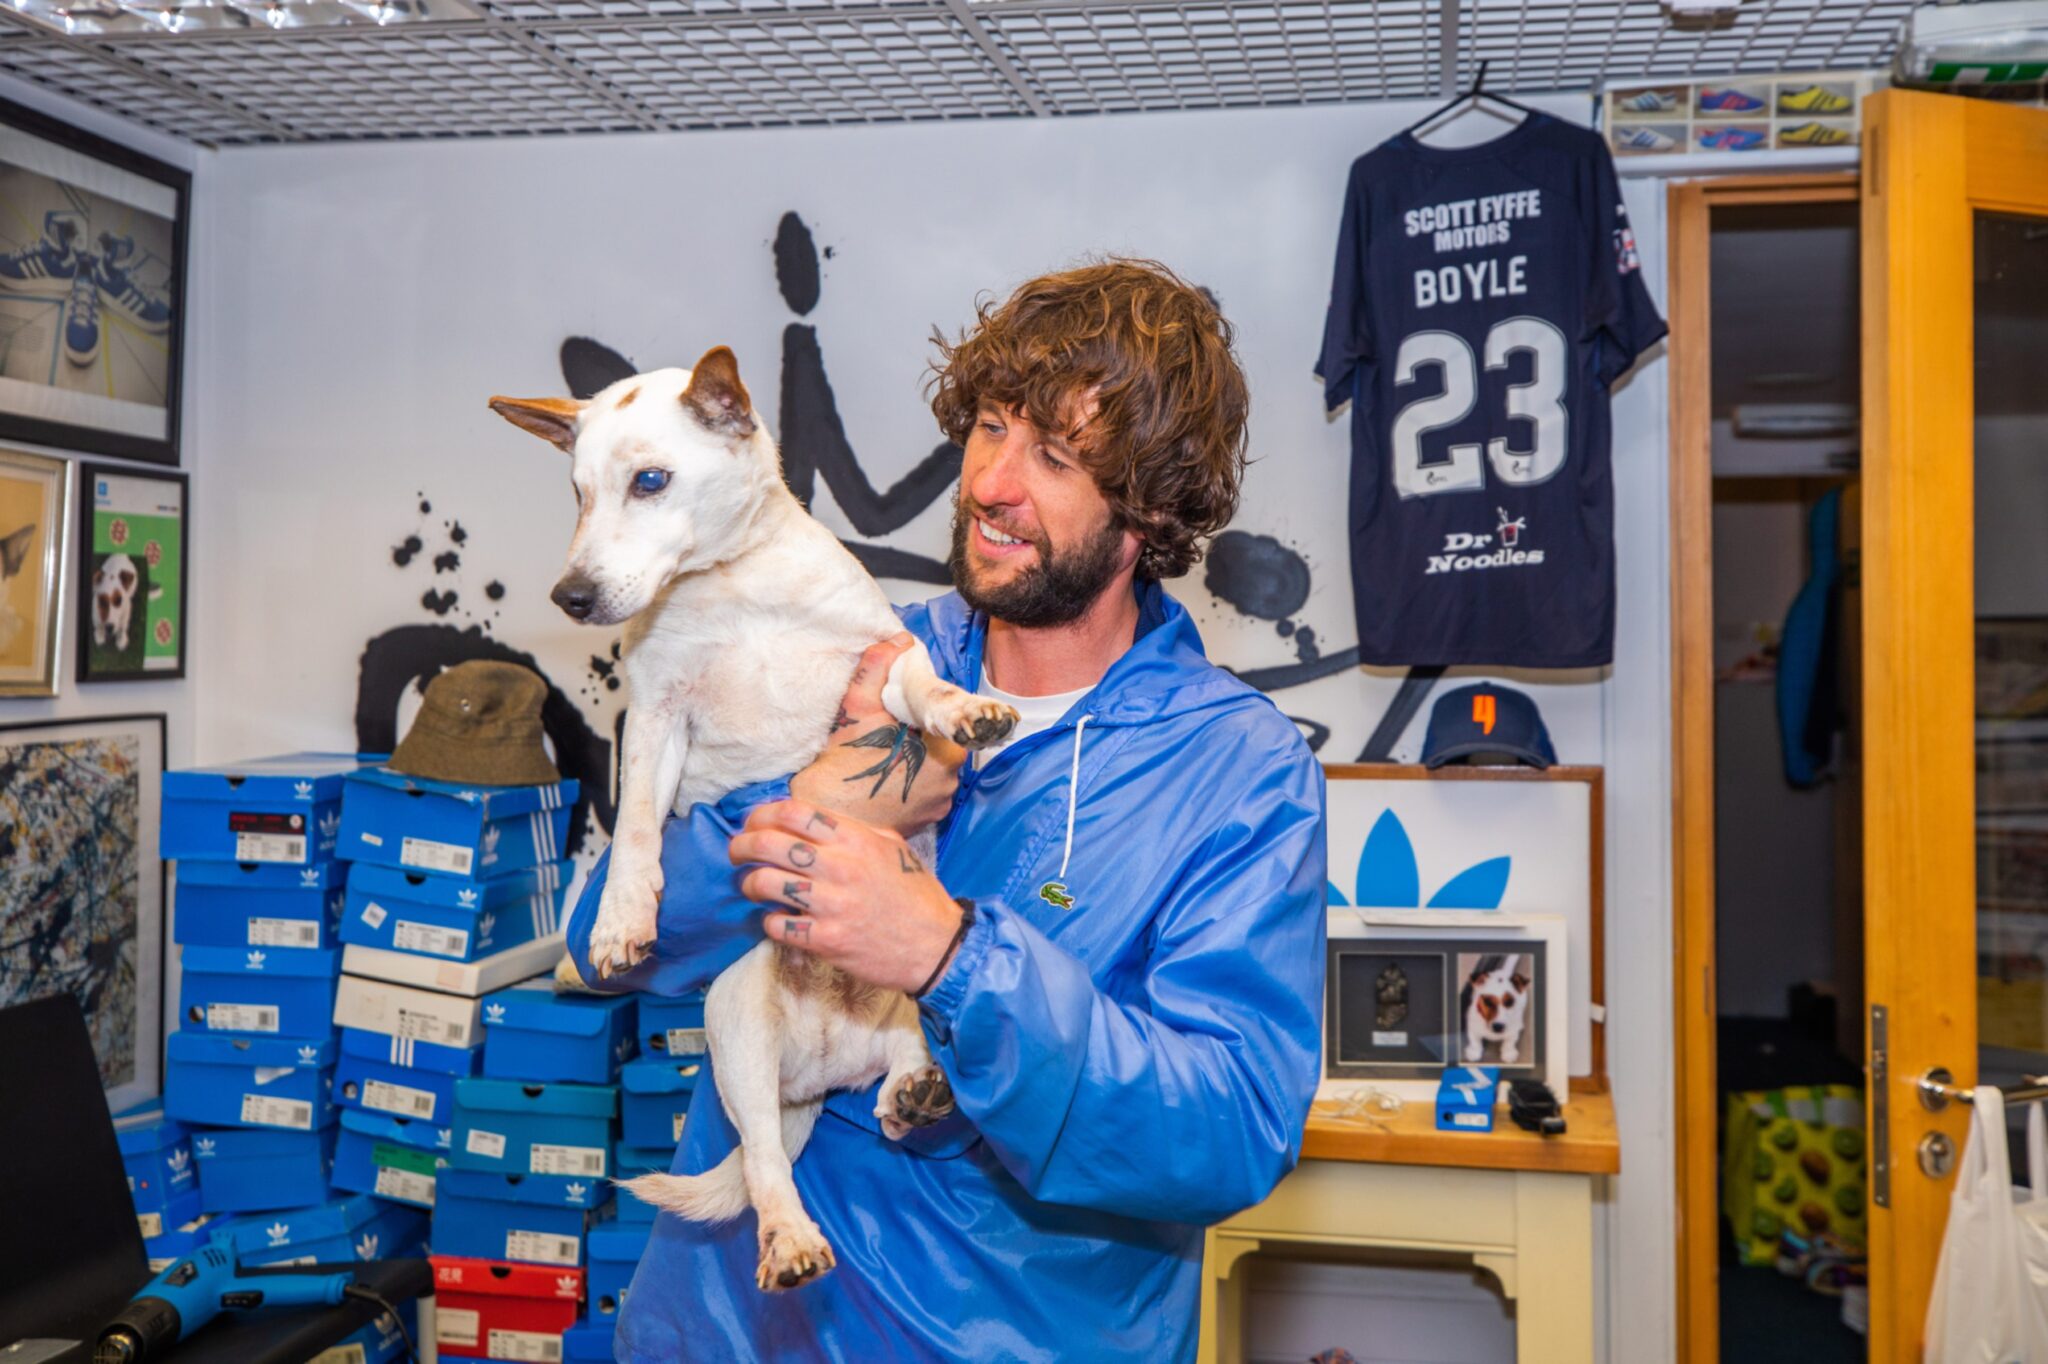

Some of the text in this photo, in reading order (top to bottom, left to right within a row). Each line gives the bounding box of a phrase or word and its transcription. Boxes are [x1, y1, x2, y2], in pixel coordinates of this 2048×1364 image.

[1404, 189, 1542, 237] SCOTT FYFFE
[1434, 220, 1510, 253] MOTORS
[1414, 255, 1528, 308] BOYLE
[1391, 315, 1569, 500] 23
[1424, 548, 1545, 574] Noodles
[1443, 532, 1493, 551] Dr
